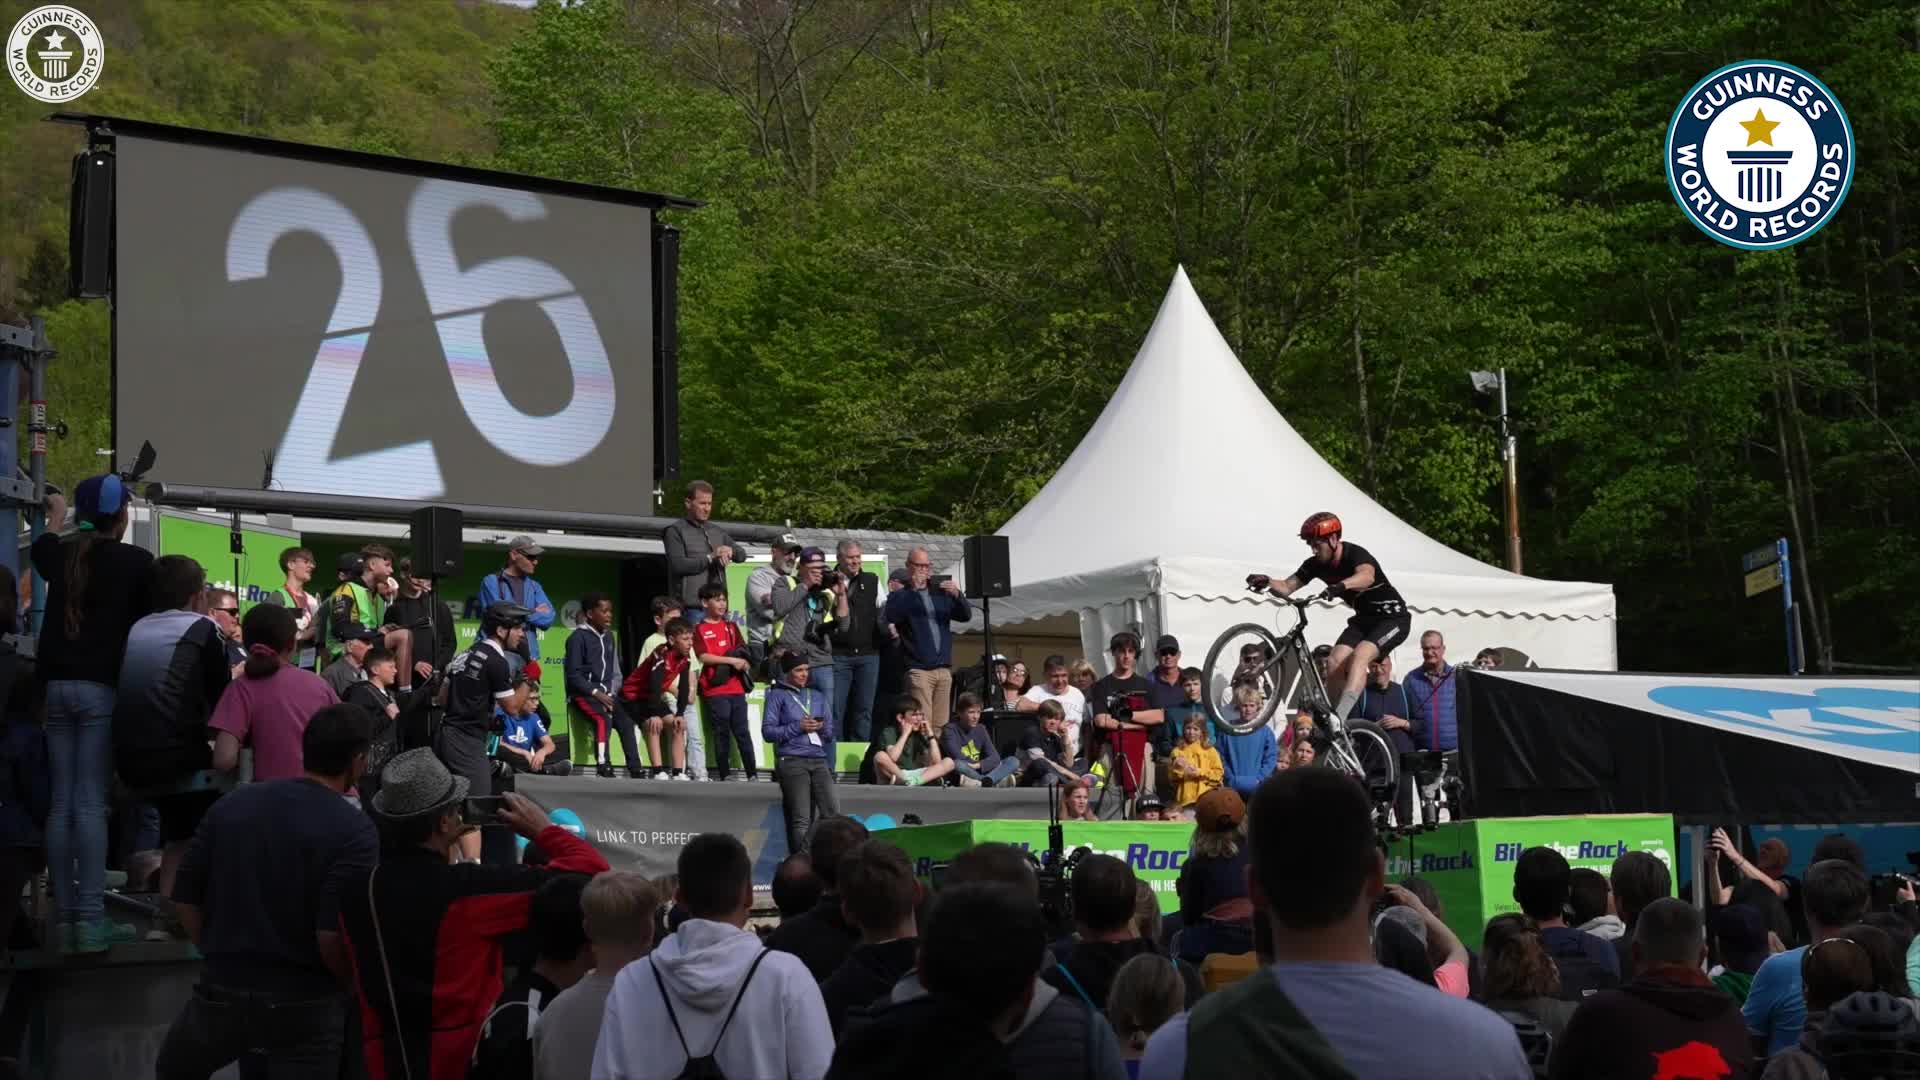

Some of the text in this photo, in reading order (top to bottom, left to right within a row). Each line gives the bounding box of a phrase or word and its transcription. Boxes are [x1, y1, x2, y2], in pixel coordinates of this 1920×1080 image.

[226, 178, 616, 499] 26
[597, 830, 627, 844] LINK
[631, 831, 647, 845] TO
